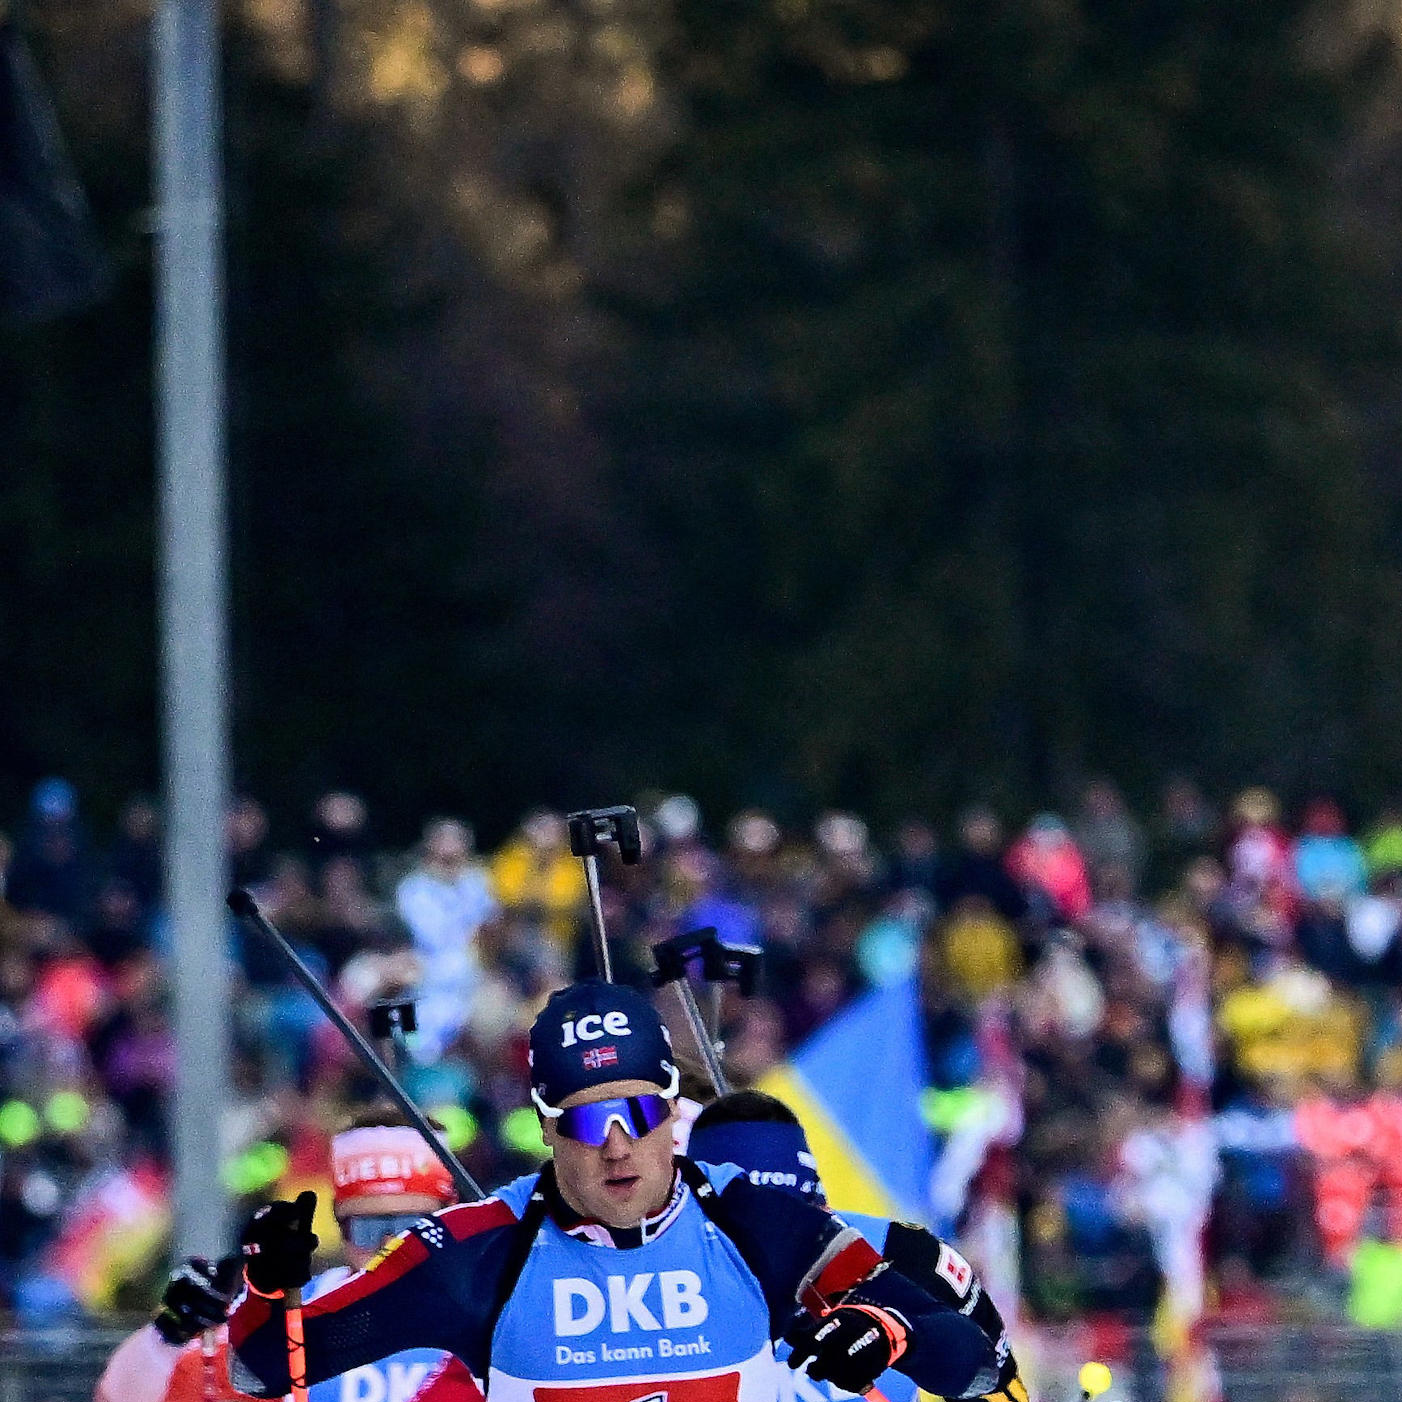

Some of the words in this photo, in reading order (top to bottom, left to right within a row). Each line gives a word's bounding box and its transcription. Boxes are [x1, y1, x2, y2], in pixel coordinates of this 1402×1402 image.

[552, 1270, 708, 1337] DKB
[555, 1344, 597, 1365] Das
[602, 1341, 653, 1361] kann
[659, 1336, 712, 1357] Bank
